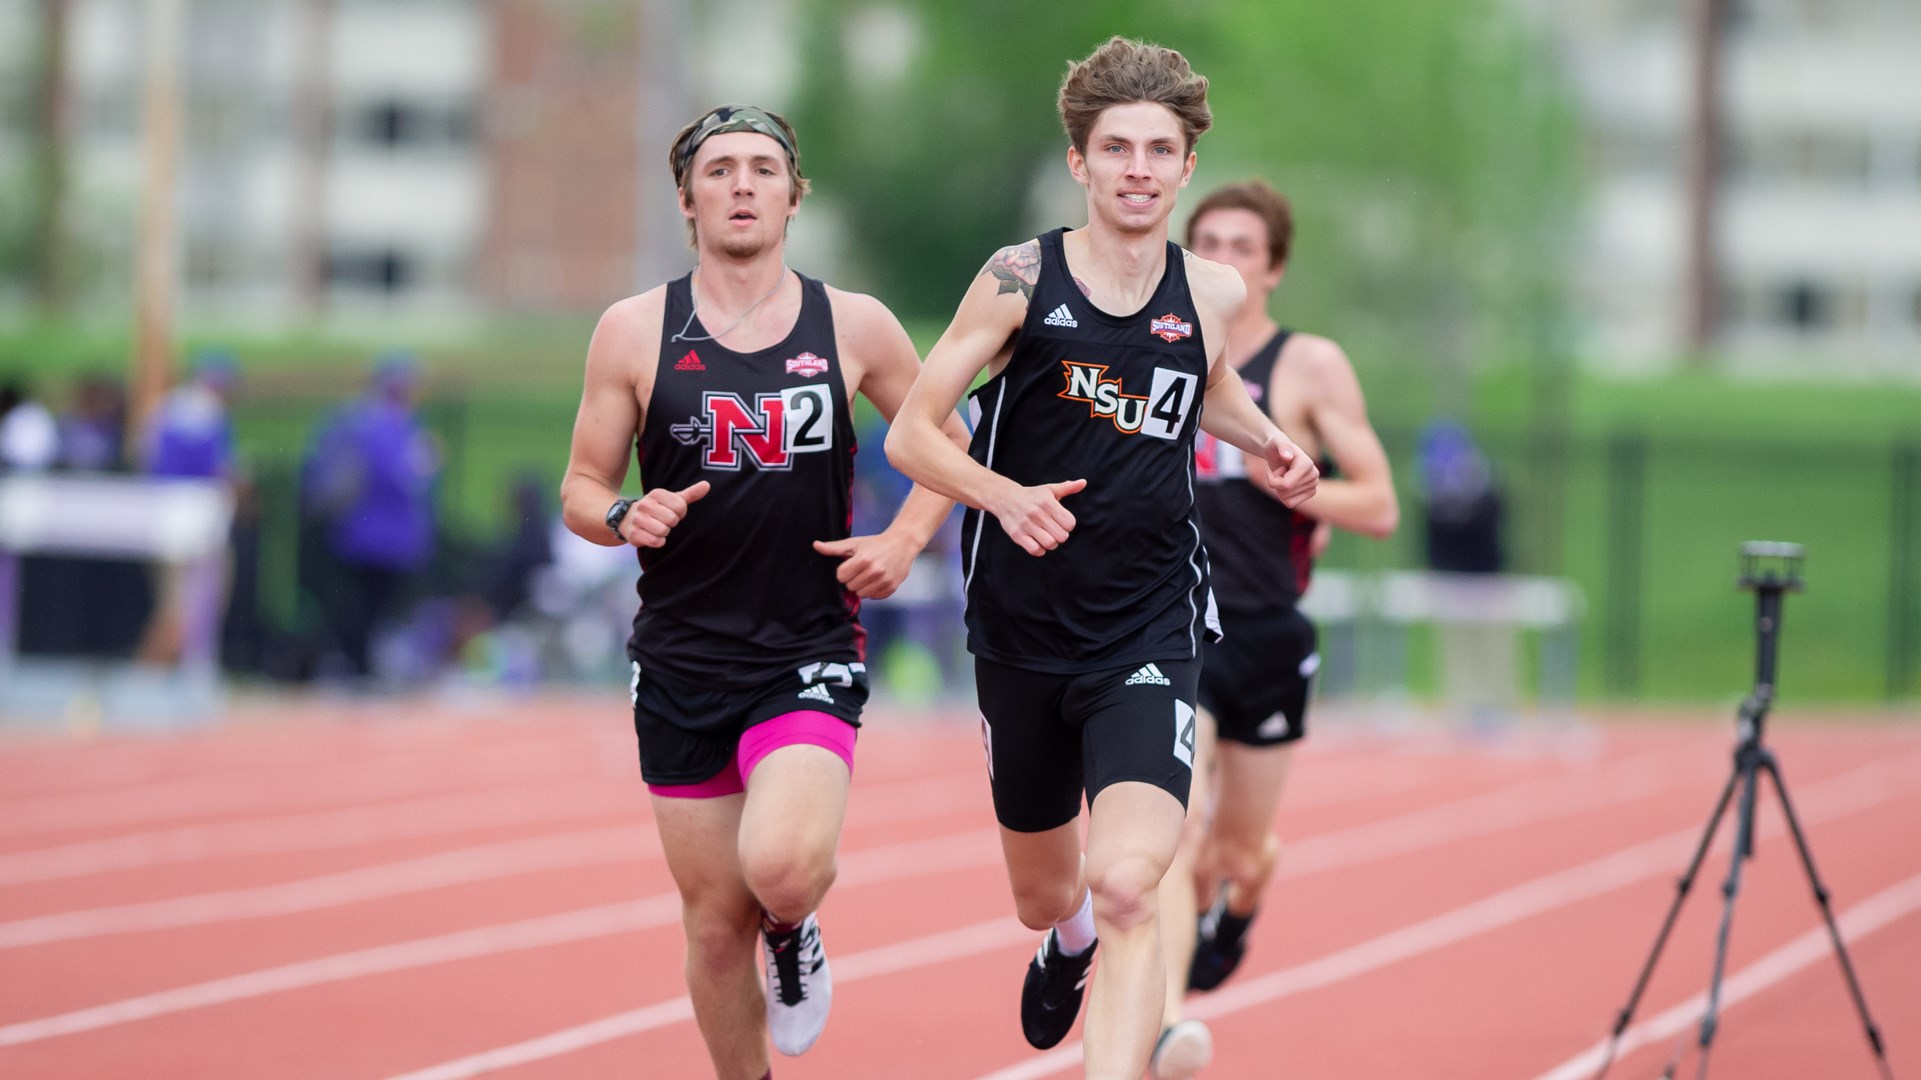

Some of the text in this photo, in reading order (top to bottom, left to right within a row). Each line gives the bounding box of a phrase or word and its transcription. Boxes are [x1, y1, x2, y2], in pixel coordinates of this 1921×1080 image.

[1044, 316, 1078, 328] adidas
[1152, 319, 1192, 336] SOUTHLAND
[790, 390, 826, 447] 2
[1062, 362, 1149, 432] NSU
[1151, 376, 1187, 434] 4
[703, 391, 793, 471] N
[1125, 674, 1171, 686] adidas
